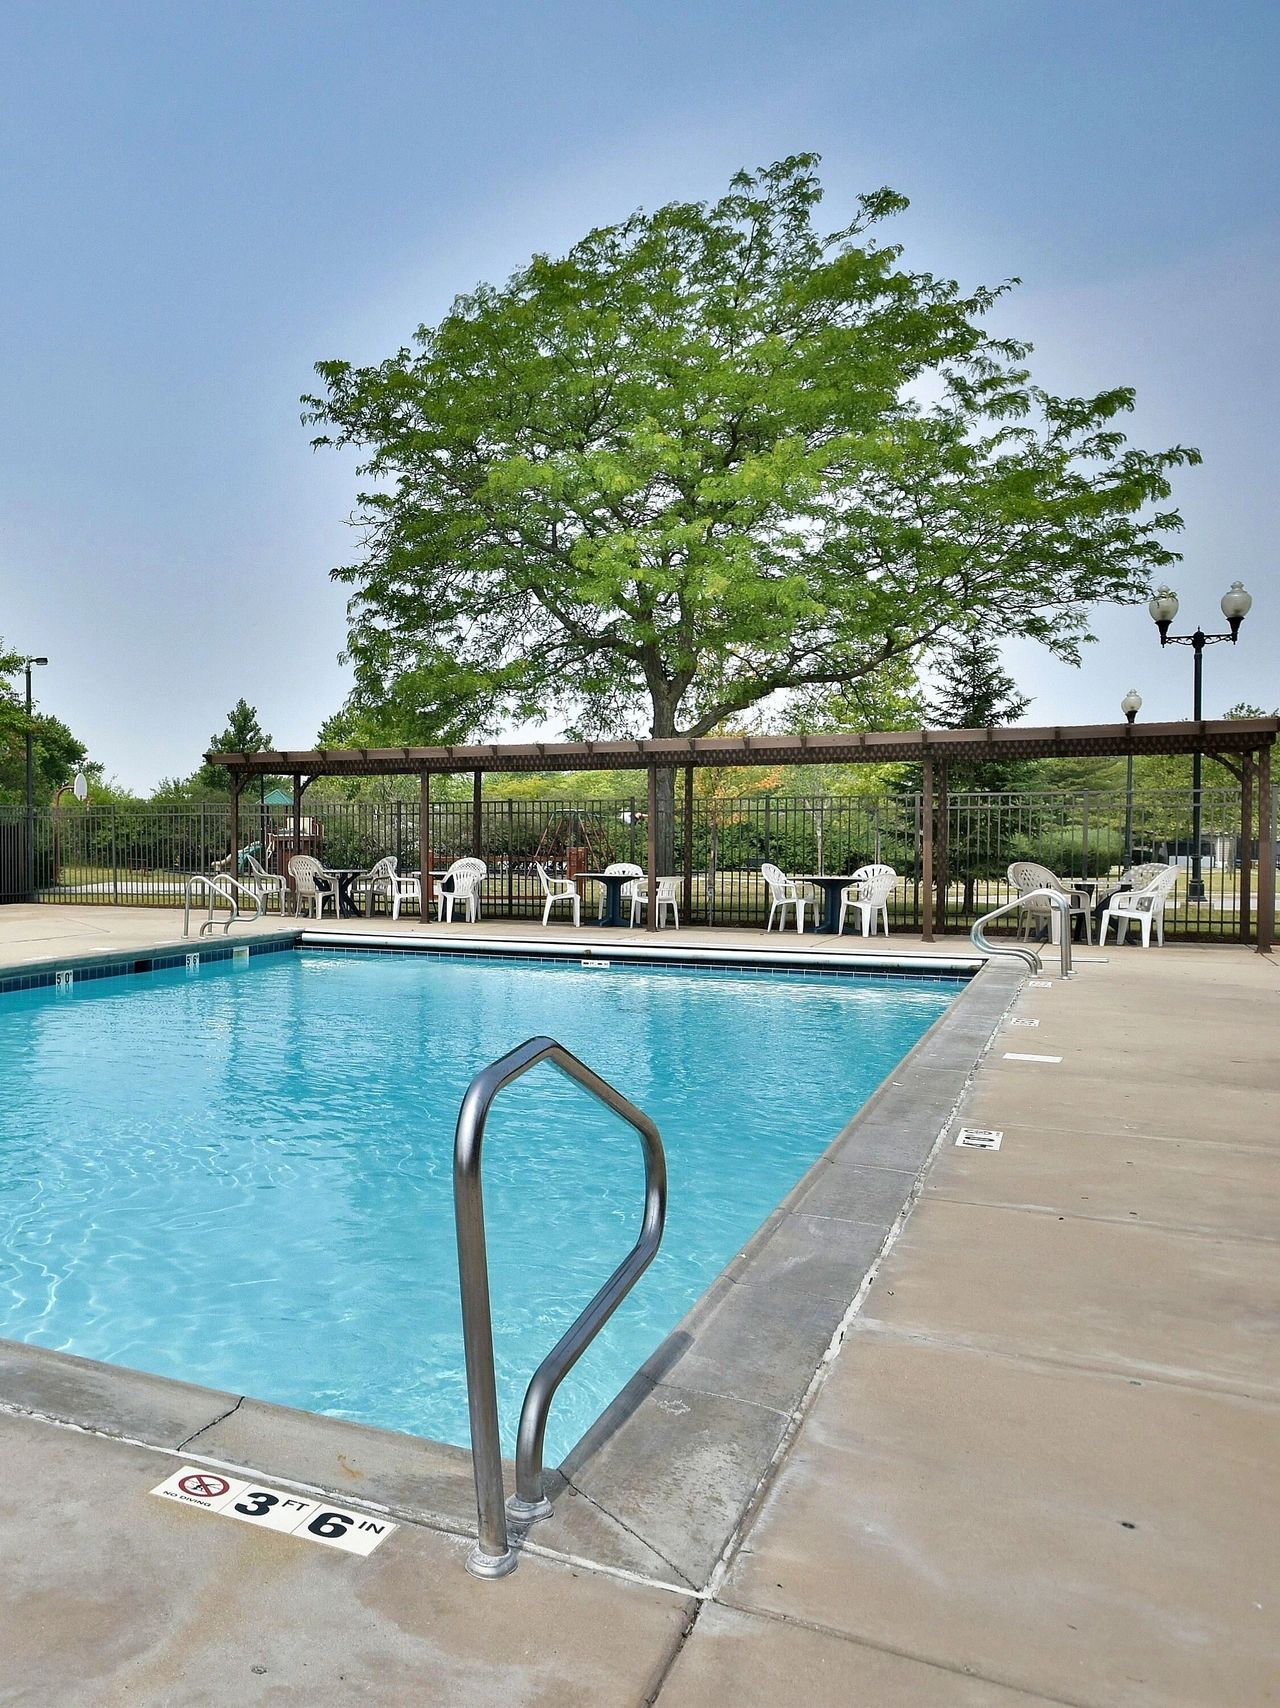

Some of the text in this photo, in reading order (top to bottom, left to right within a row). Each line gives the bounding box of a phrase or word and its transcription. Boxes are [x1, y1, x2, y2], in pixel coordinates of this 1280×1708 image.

[56, 973, 62, 985] 5
[162, 1490, 212, 1508] NO DIVING
[234, 1492, 386, 1539] 3 FT 6 IN
